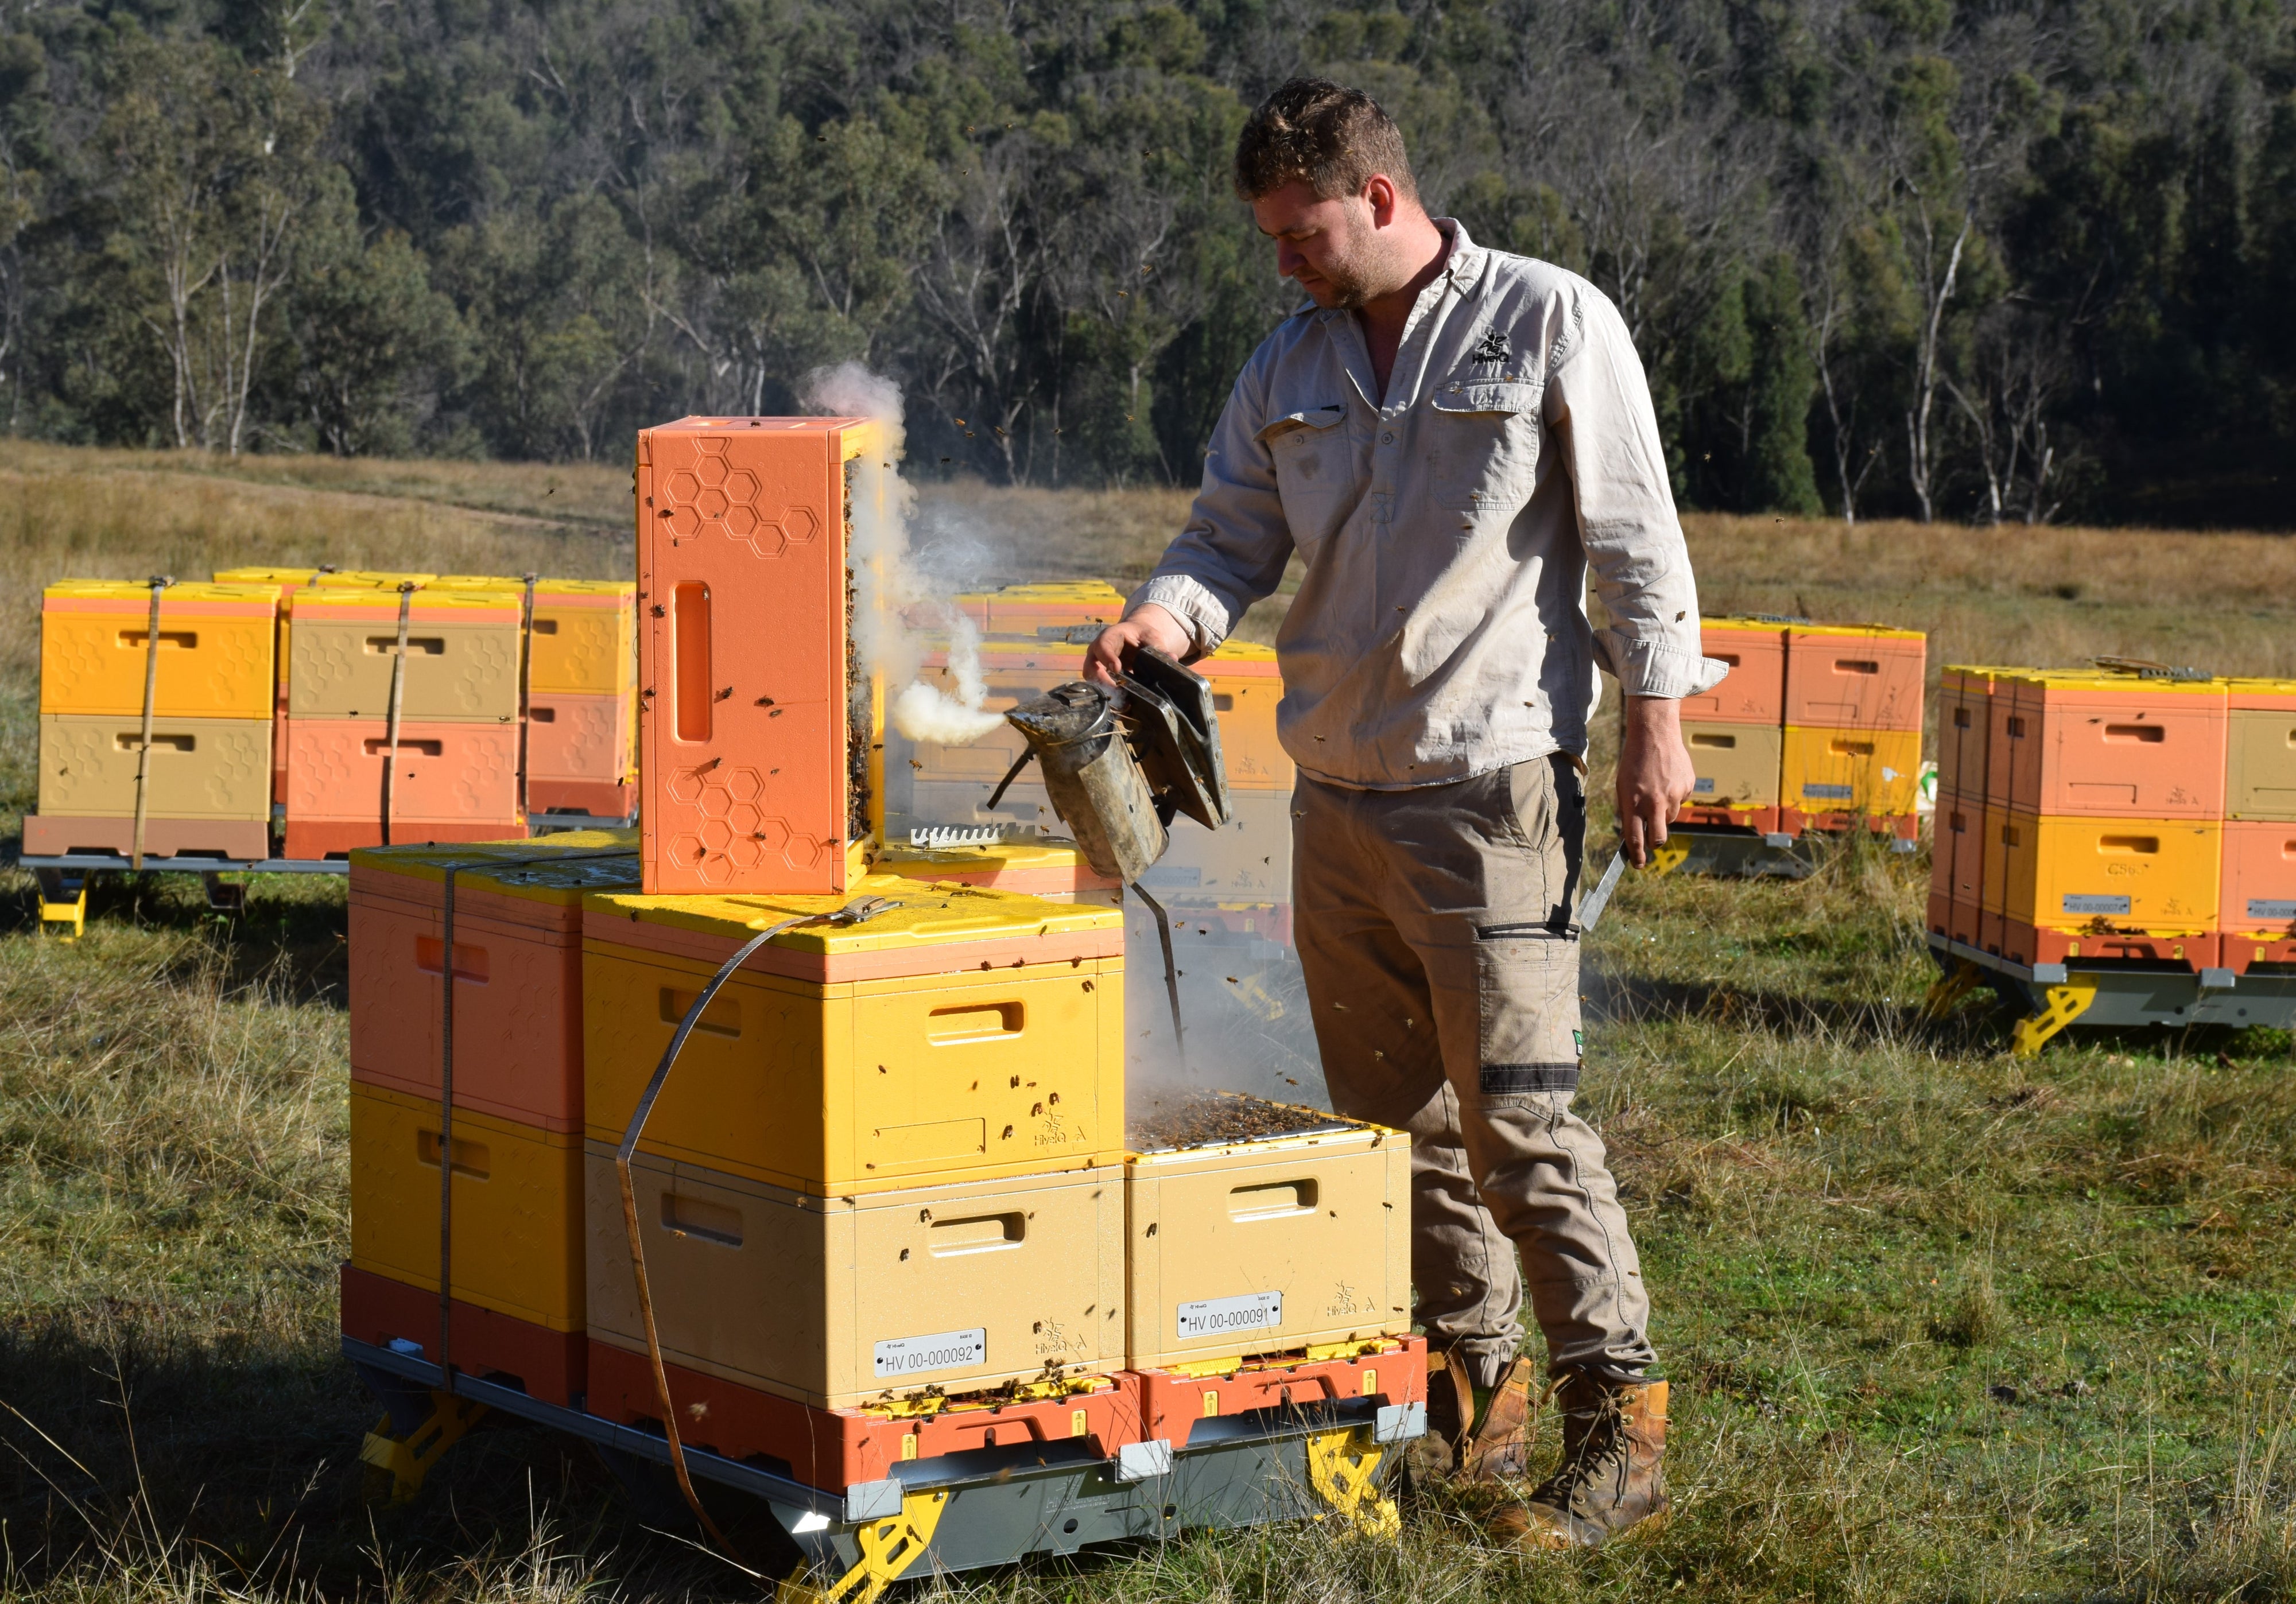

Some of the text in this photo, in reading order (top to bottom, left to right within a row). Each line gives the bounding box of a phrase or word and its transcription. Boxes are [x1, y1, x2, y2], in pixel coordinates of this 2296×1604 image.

[1472, 352, 1510, 364] HiveIQ
[1189, 1307, 1267, 1331] HV 00-000091
[886, 1346, 973, 1372] HV 00-000092
